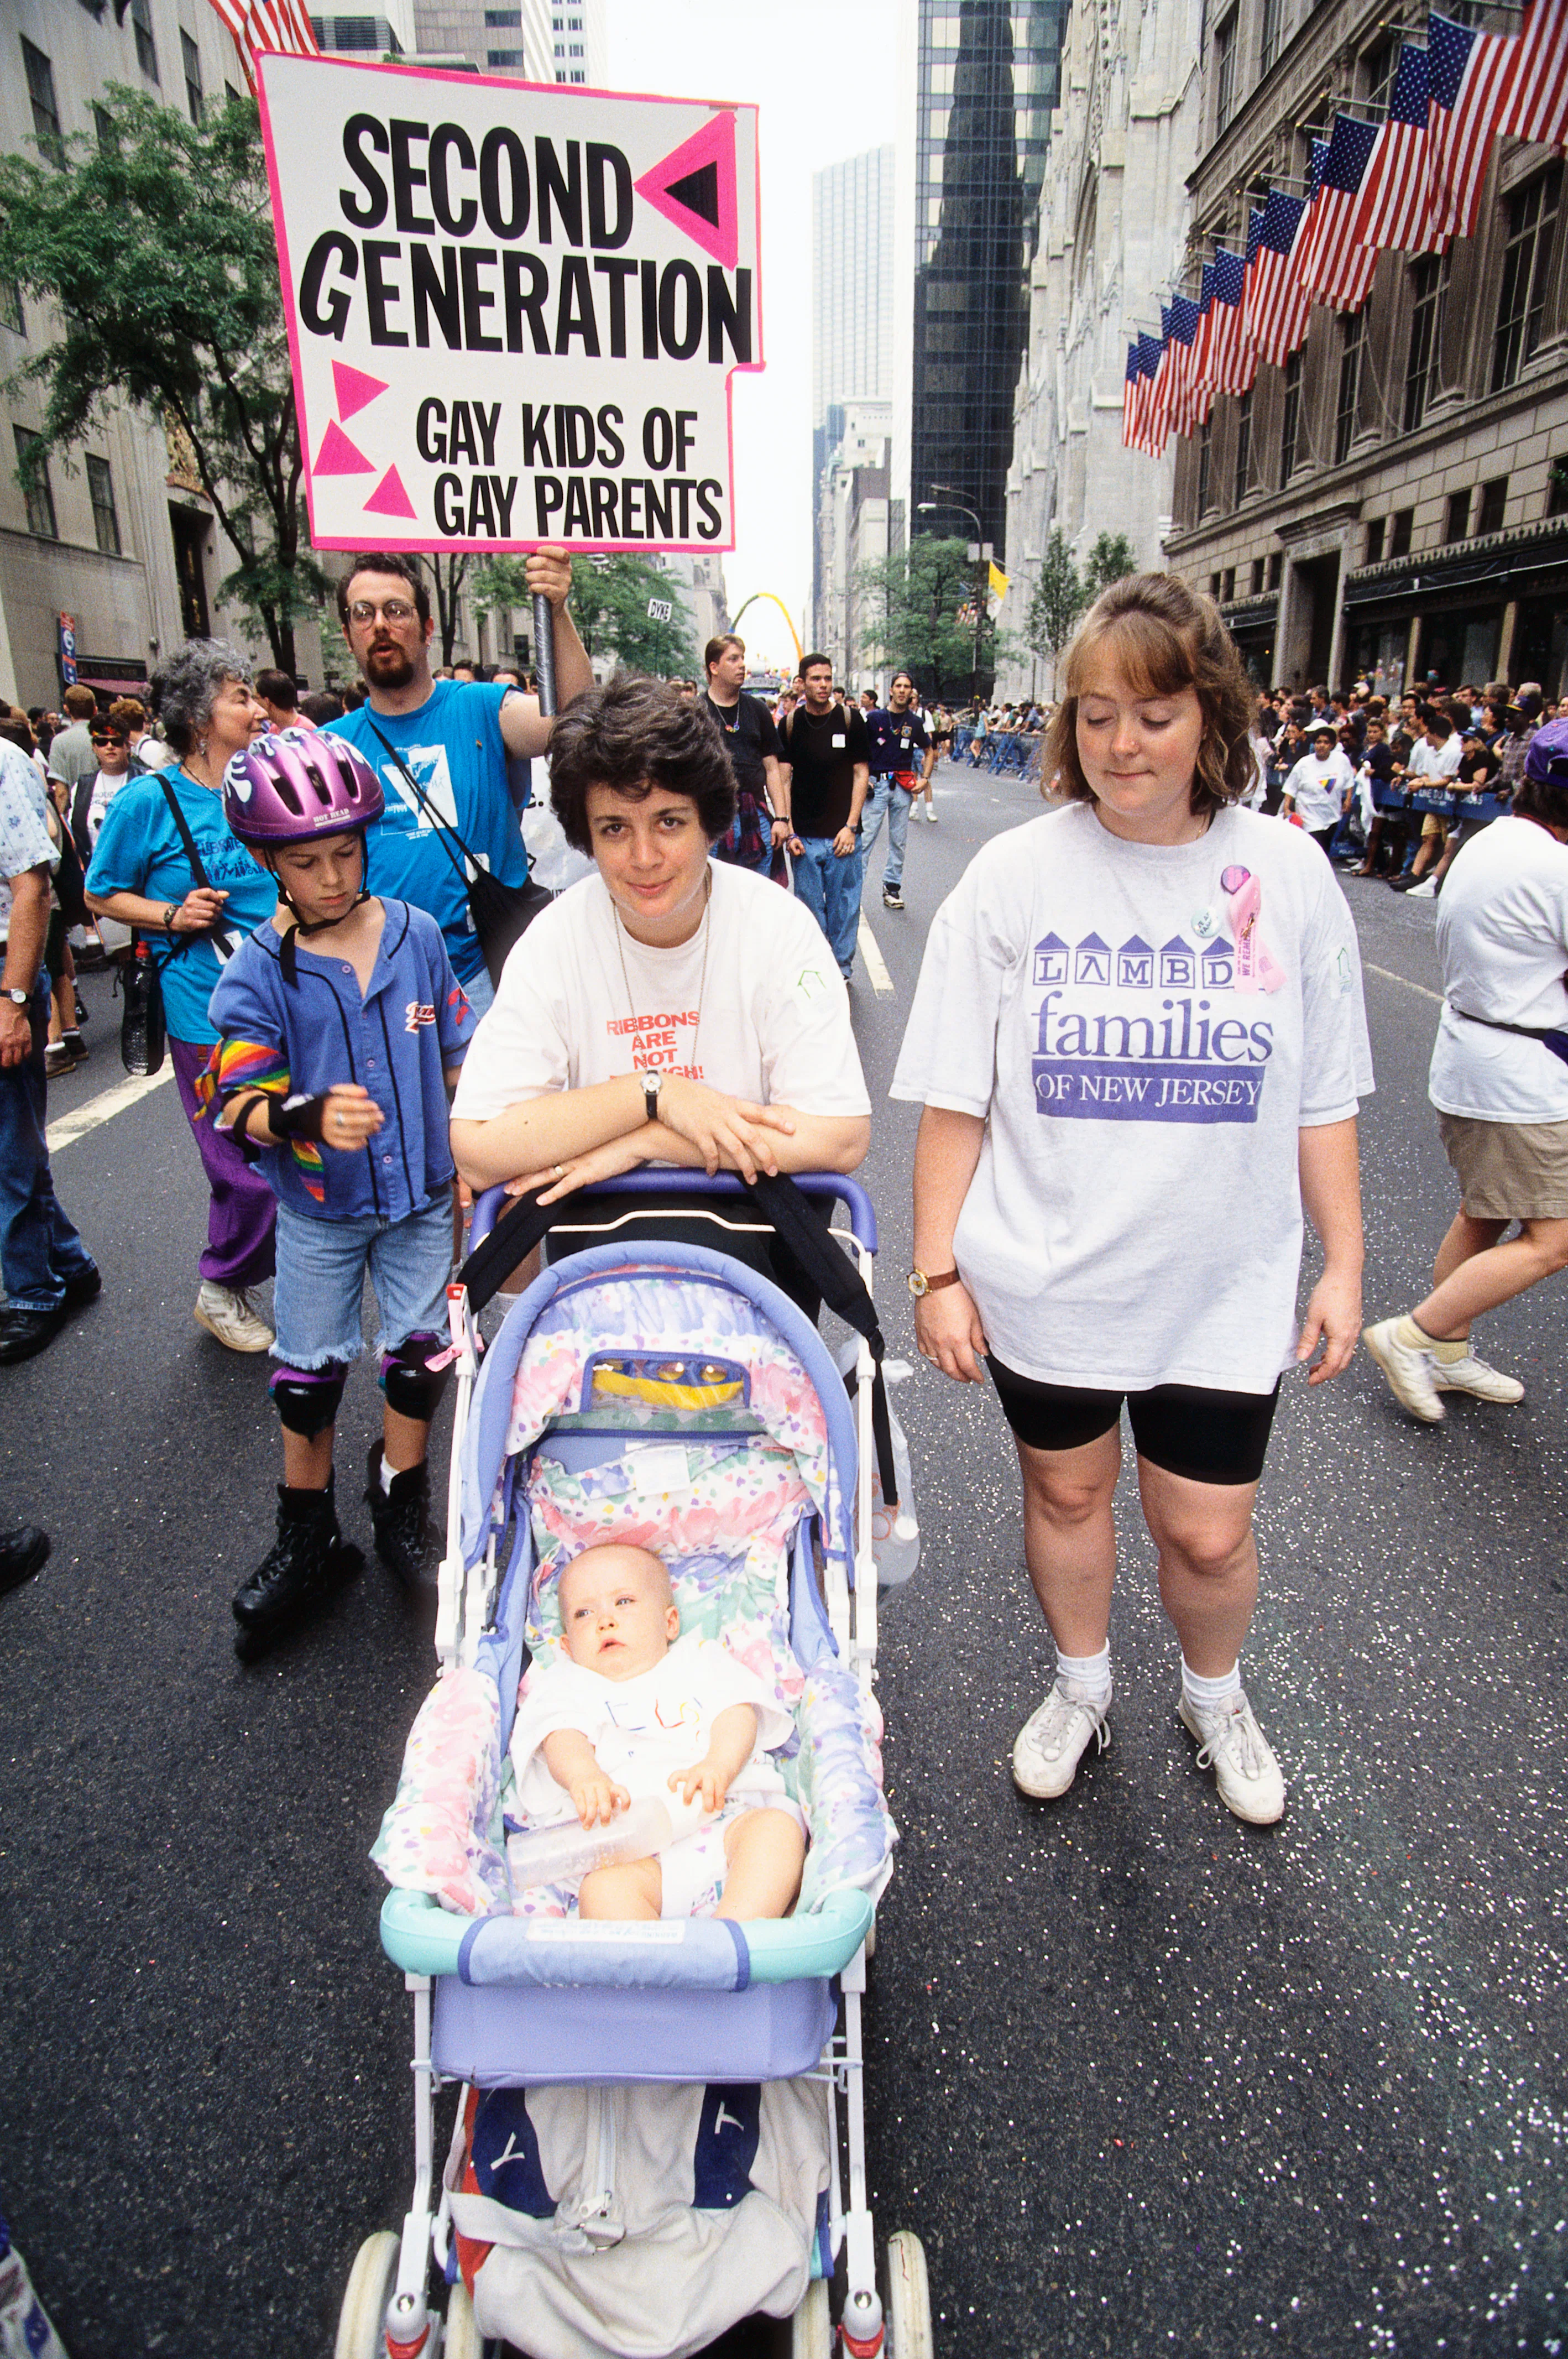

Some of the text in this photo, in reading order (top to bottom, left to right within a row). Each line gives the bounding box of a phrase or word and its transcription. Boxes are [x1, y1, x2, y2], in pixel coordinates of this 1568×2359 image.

[339, 113, 633, 250] SECOND
[299, 231, 751, 364] GENERATION
[416, 397, 698, 472] GAY KIDS OF
[434, 473, 723, 540] GAY PARENTS
[651, 602, 669, 620] DYKE
[313, 808, 350, 823] HOT HEAD
[607, 1011, 700, 1036] RIBBONS
[1032, 990, 1273, 1062] families
[631, 1030, 676, 1052] ARE
[633, 1048, 678, 1070] NOT
[1036, 1073, 1262, 1107] OF NEW JERSEY
